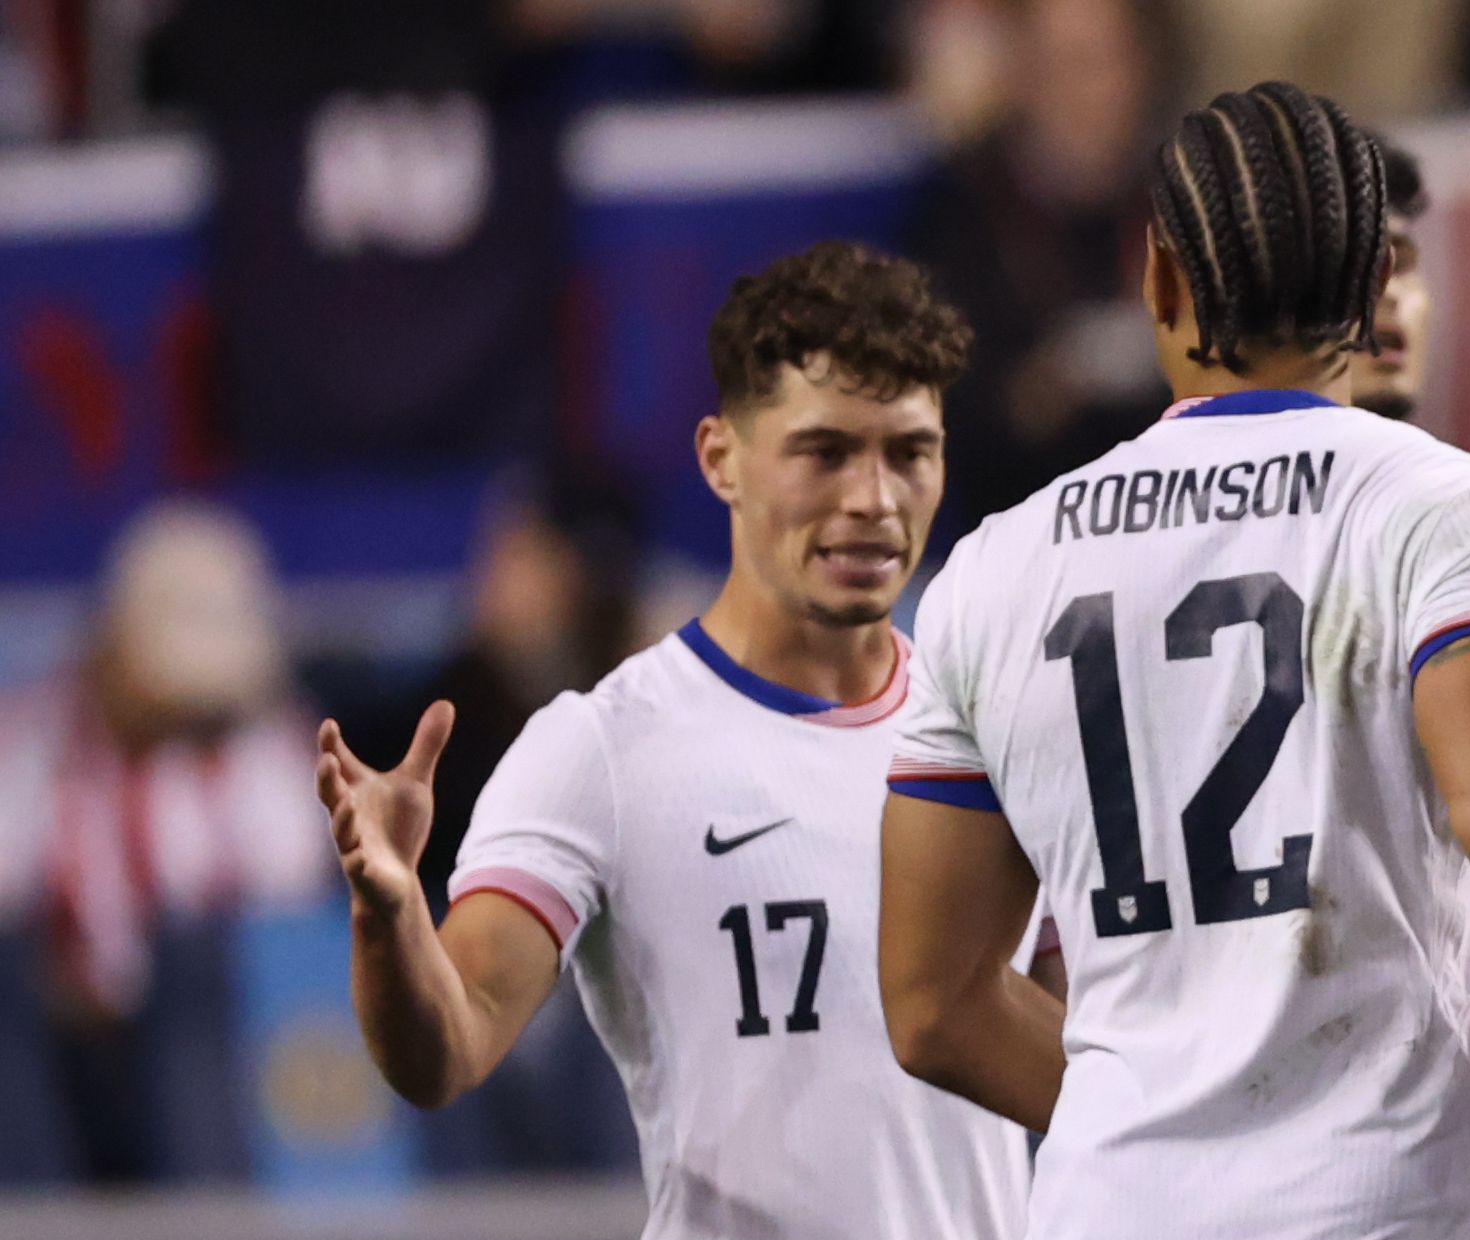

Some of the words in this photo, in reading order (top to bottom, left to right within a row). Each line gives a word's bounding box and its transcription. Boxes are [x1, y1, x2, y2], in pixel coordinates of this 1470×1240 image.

[1053, 450, 1336, 545] ROBINSON
[1044, 571, 1314, 938] 12
[719, 899, 828, 1037] 17
